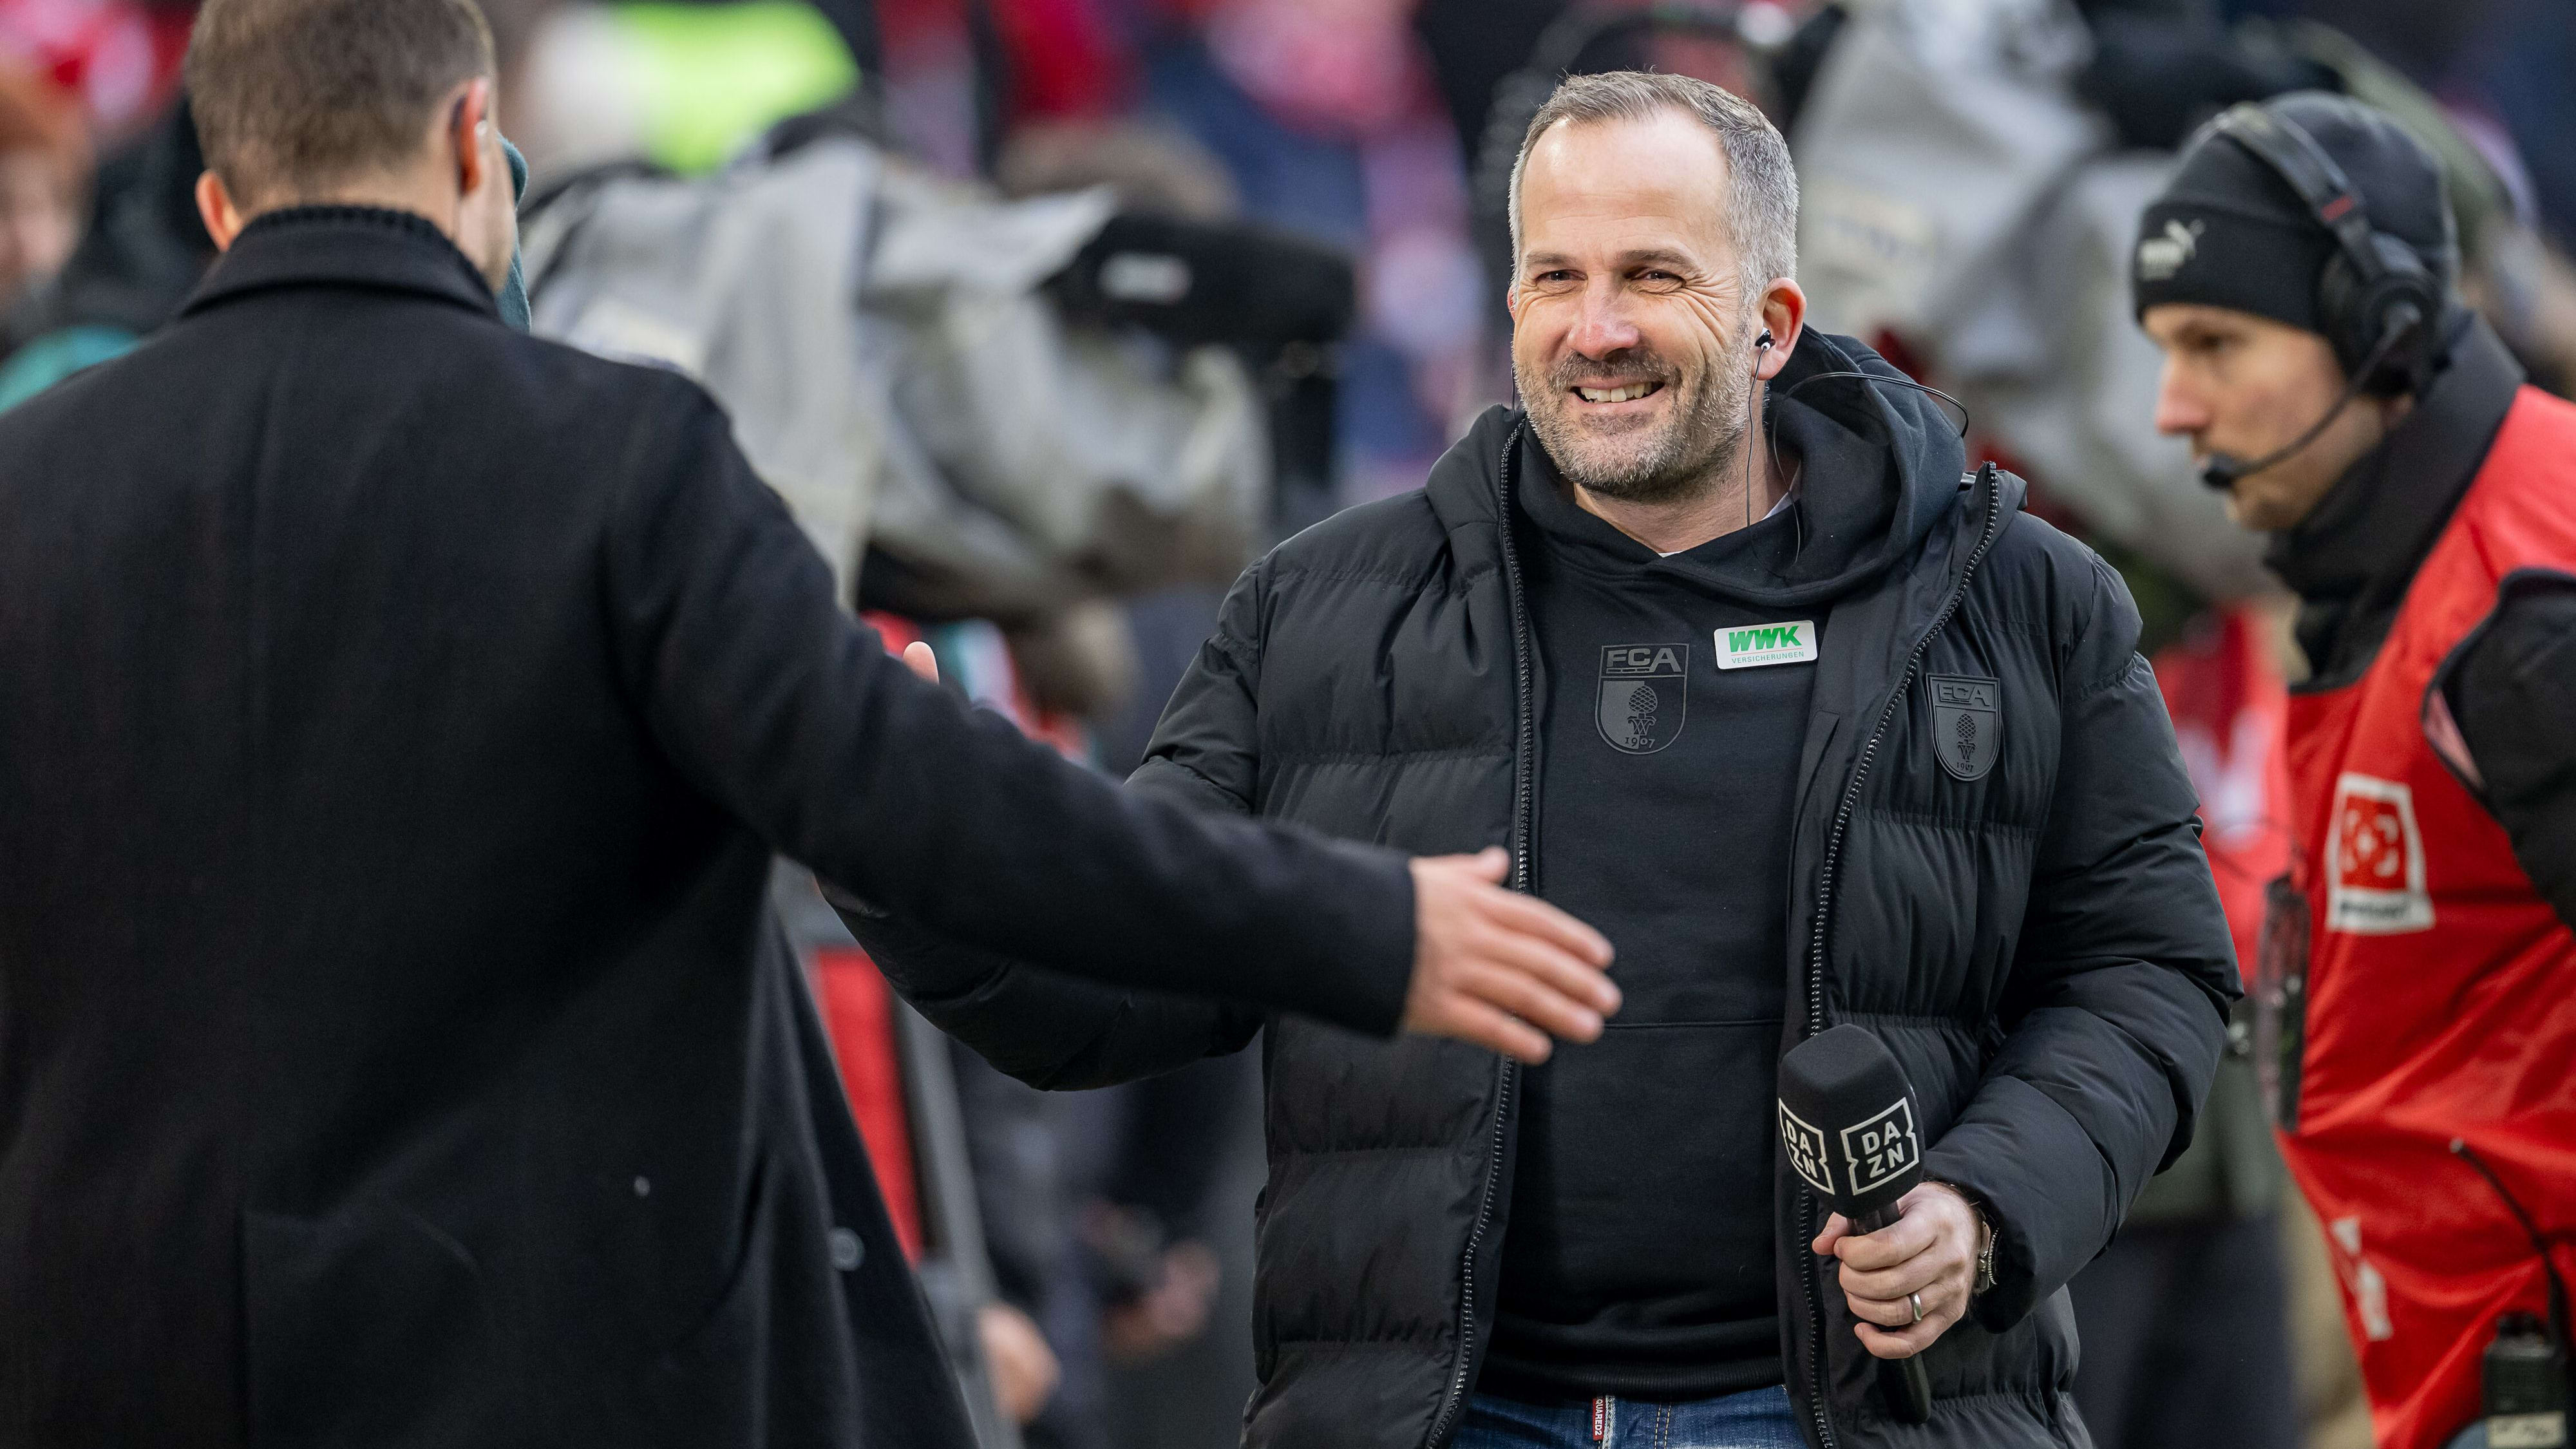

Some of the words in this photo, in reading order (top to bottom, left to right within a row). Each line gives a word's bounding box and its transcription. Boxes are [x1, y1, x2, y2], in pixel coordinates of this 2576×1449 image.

[1728, 625, 1803, 653] WWK
[1606, 648, 1682, 672] FCA
[1731, 651, 1804, 664] VERSICHERUNGEN
[1937, 683, 1991, 706] FCA
[1624, 737, 1655, 748] 1907
[1956, 762, 1974, 773] 1907
[1595, 1396, 1604, 1436] QUARED2
